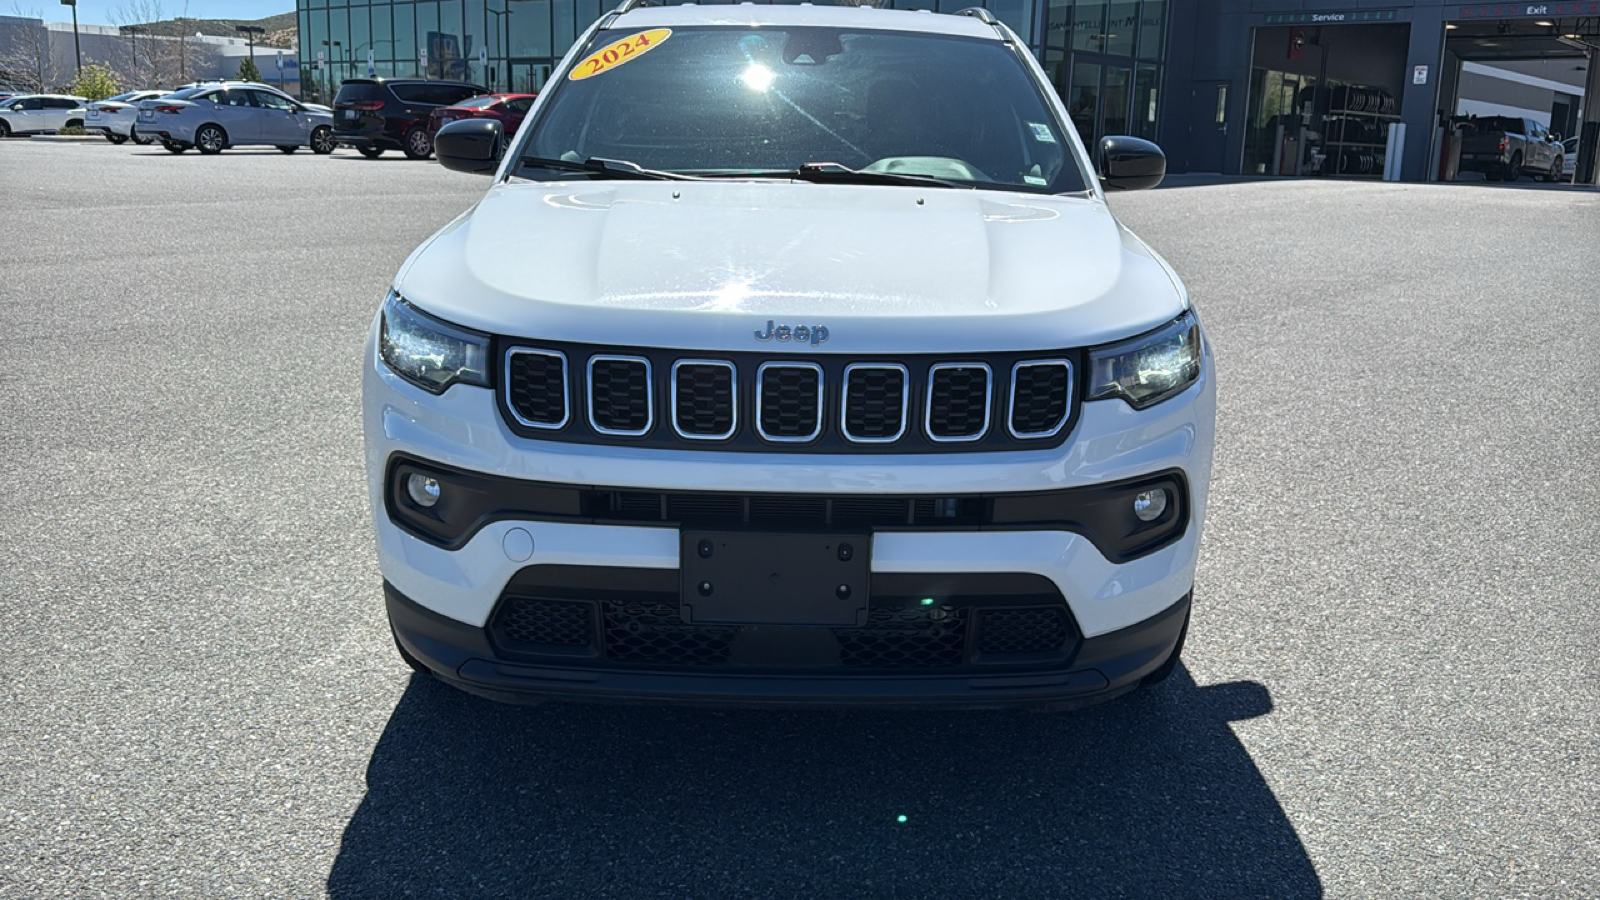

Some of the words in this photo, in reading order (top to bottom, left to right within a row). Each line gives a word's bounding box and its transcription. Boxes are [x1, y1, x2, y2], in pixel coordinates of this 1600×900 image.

[1312, 13, 1345, 21] Service
[1526, 5, 1547, 15] Exit
[586, 34, 650, 74] 2024
[754, 319, 830, 347] Jeep
